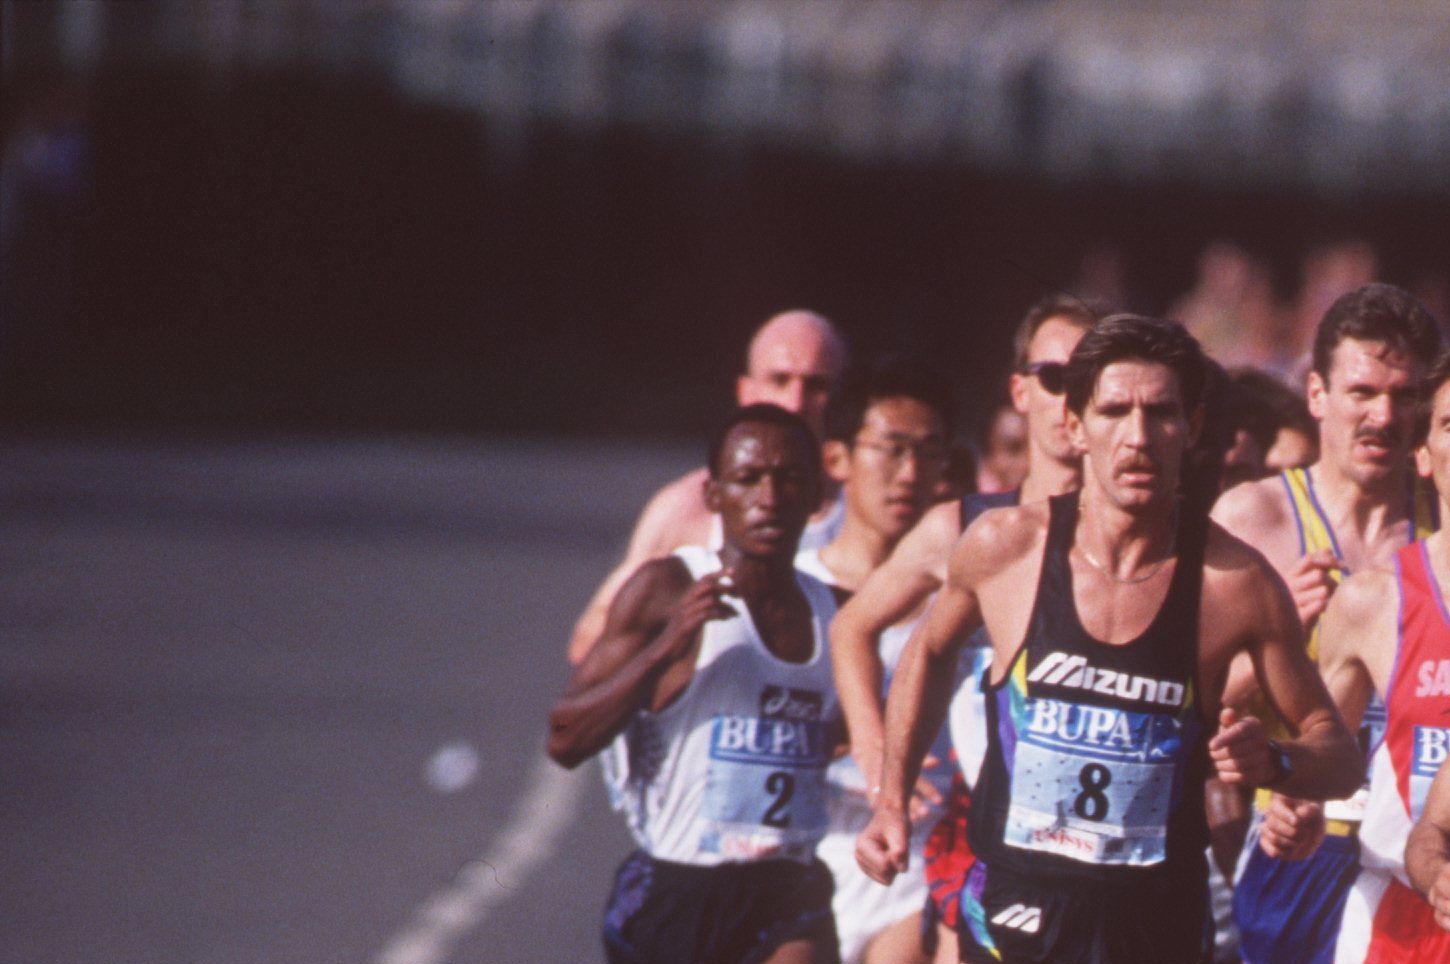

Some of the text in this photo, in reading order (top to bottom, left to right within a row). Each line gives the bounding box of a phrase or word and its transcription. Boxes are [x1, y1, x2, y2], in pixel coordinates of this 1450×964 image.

[717, 714, 808, 755] BUPA
[1028, 699, 1133, 748] BUPA
[761, 771, 795, 829] 2
[1074, 762, 1113, 822] 8
